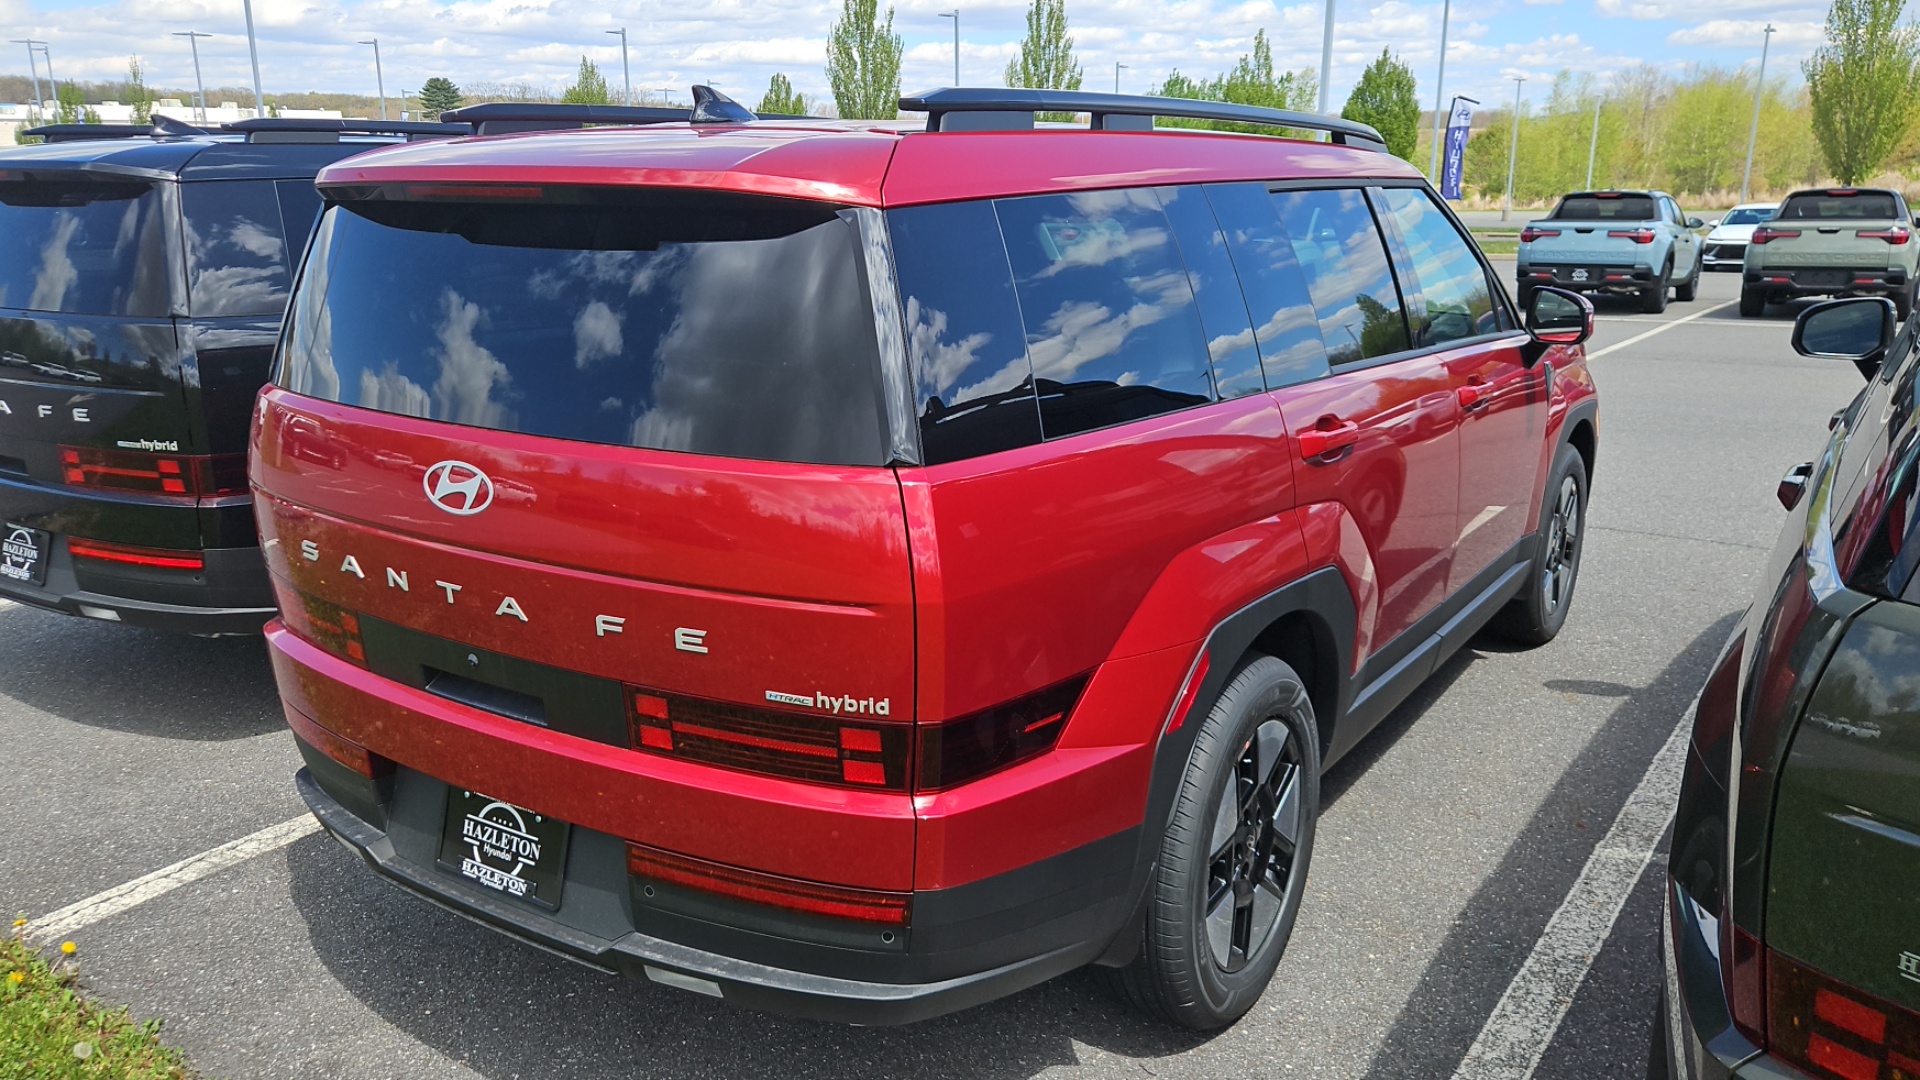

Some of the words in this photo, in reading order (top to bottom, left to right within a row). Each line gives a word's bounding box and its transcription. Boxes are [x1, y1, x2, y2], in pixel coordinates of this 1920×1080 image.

[37, 404, 91, 422] FE
[140, 438, 179, 452] hybrid
[2, 541, 38, 560] HAZLETON
[301, 539, 529, 623] SANTA
[595, 614, 709, 654] FE
[767, 692, 812, 706] HTRAC
[816, 691, 890, 716] hybrid
[462, 818, 542, 861] HAZLETON
[483, 843, 513, 862] Hyundai
[461, 860, 528, 894] HAZLETON
